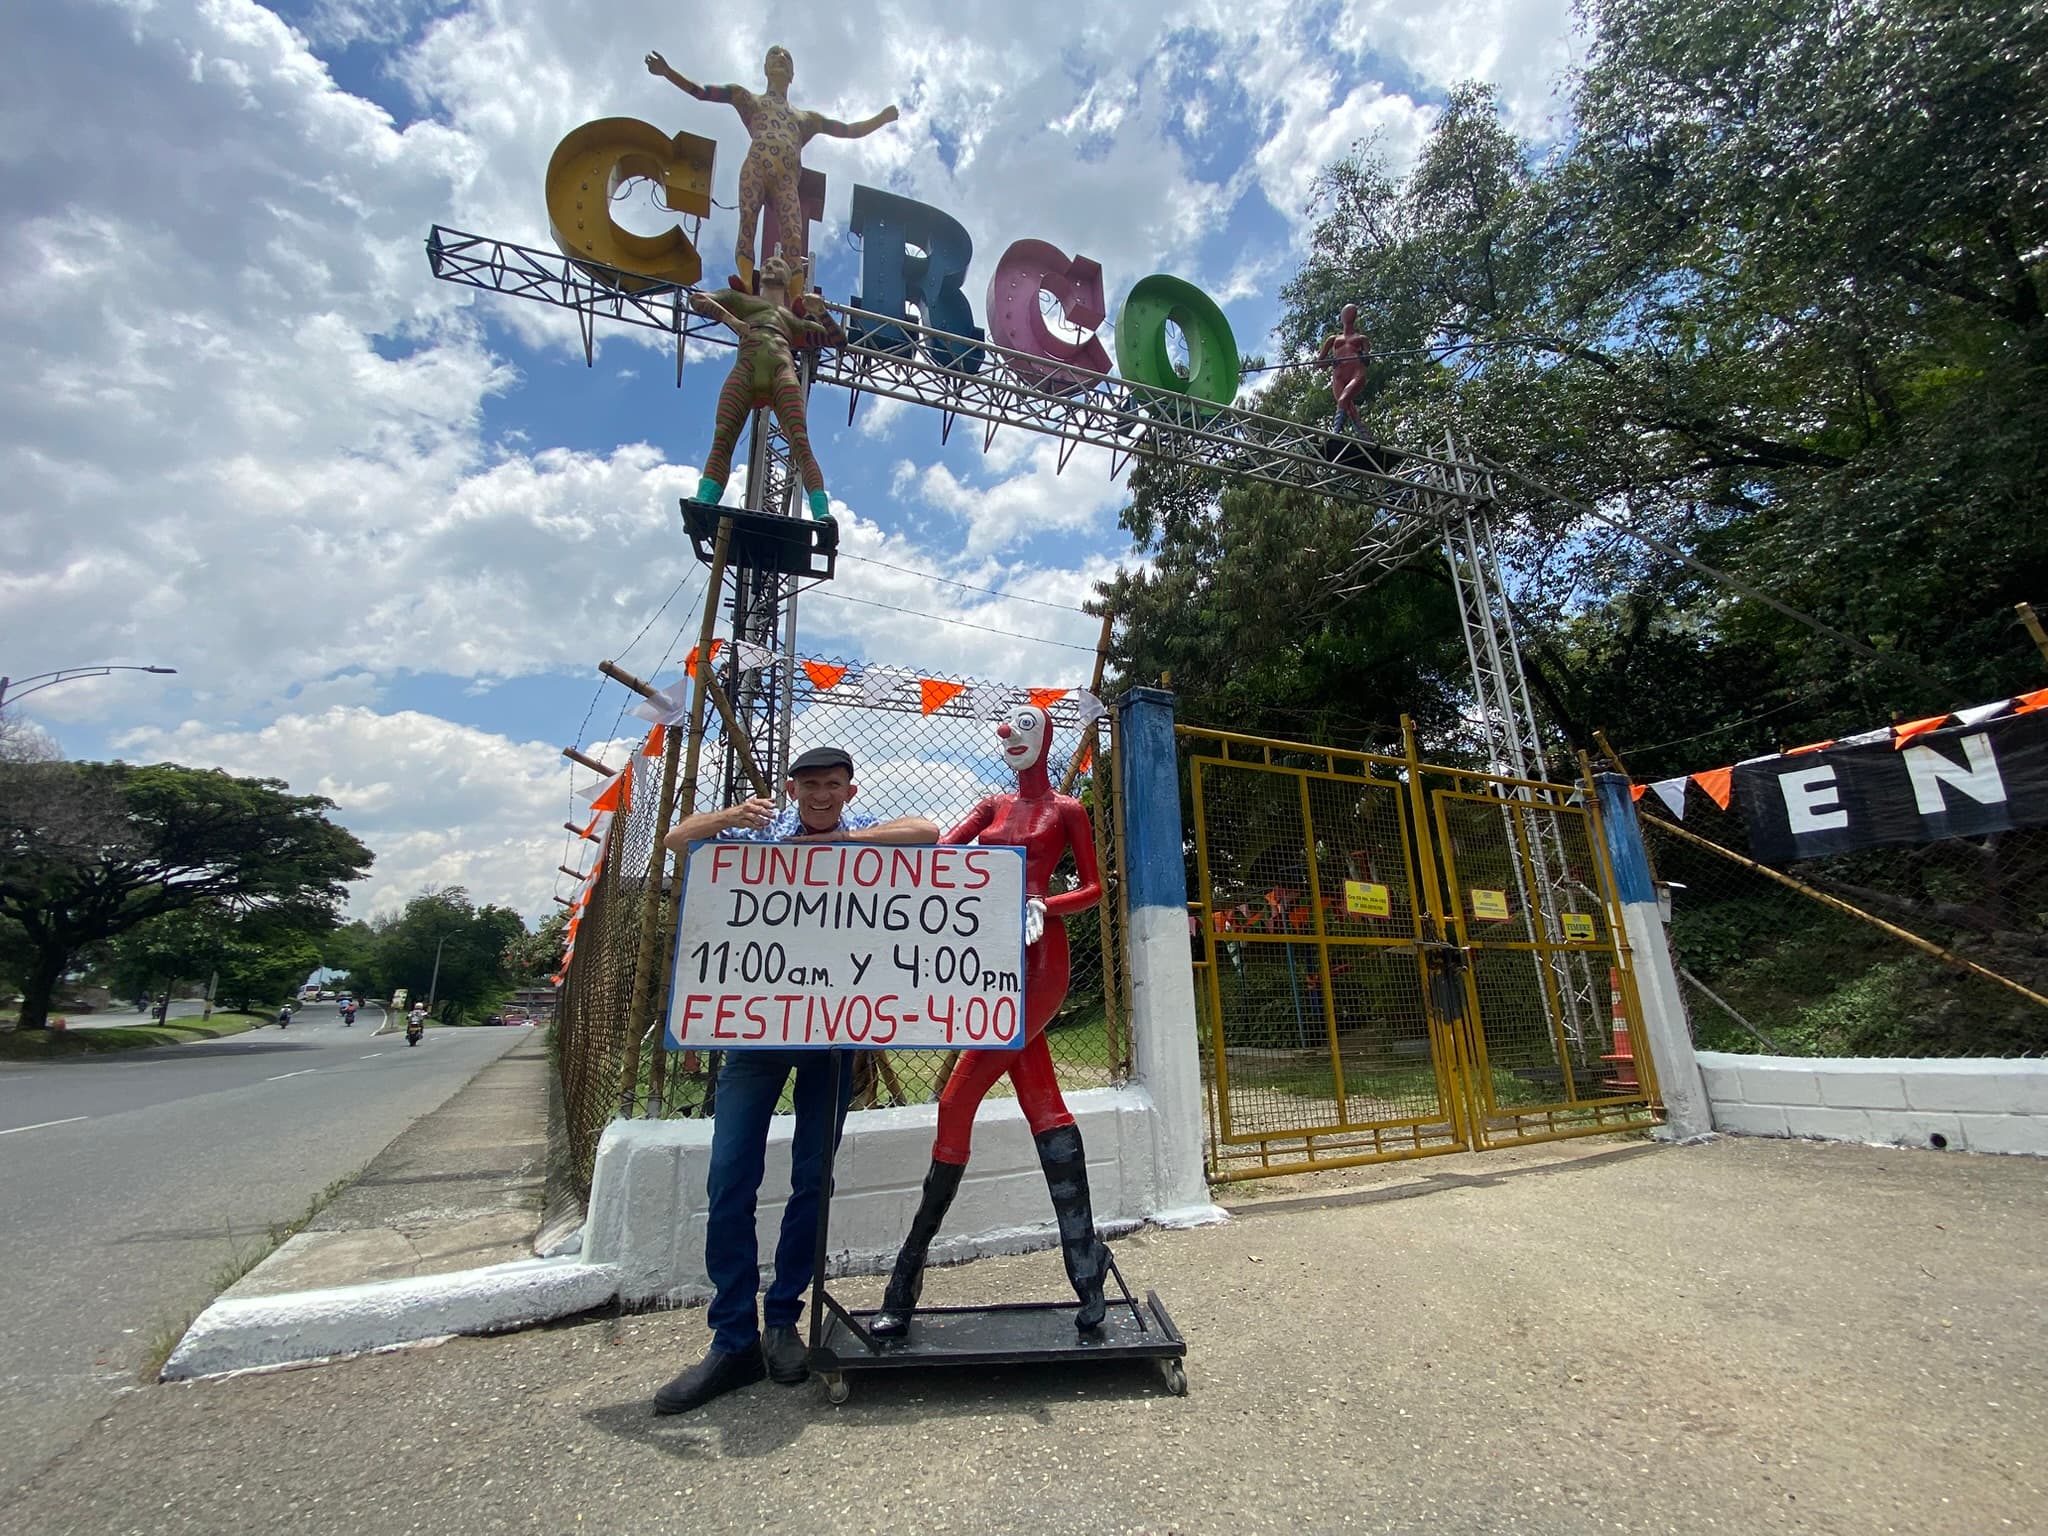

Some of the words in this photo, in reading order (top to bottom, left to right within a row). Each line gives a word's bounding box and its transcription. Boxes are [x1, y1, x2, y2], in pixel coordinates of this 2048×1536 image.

[1777, 731, 2007, 834] EN
[711, 845, 990, 889] FUNCIONES
[726, 889, 981, 937] DOMINGOS
[691, 941, 785, 984] 11:00
[893, 944, 980, 988] 4:00
